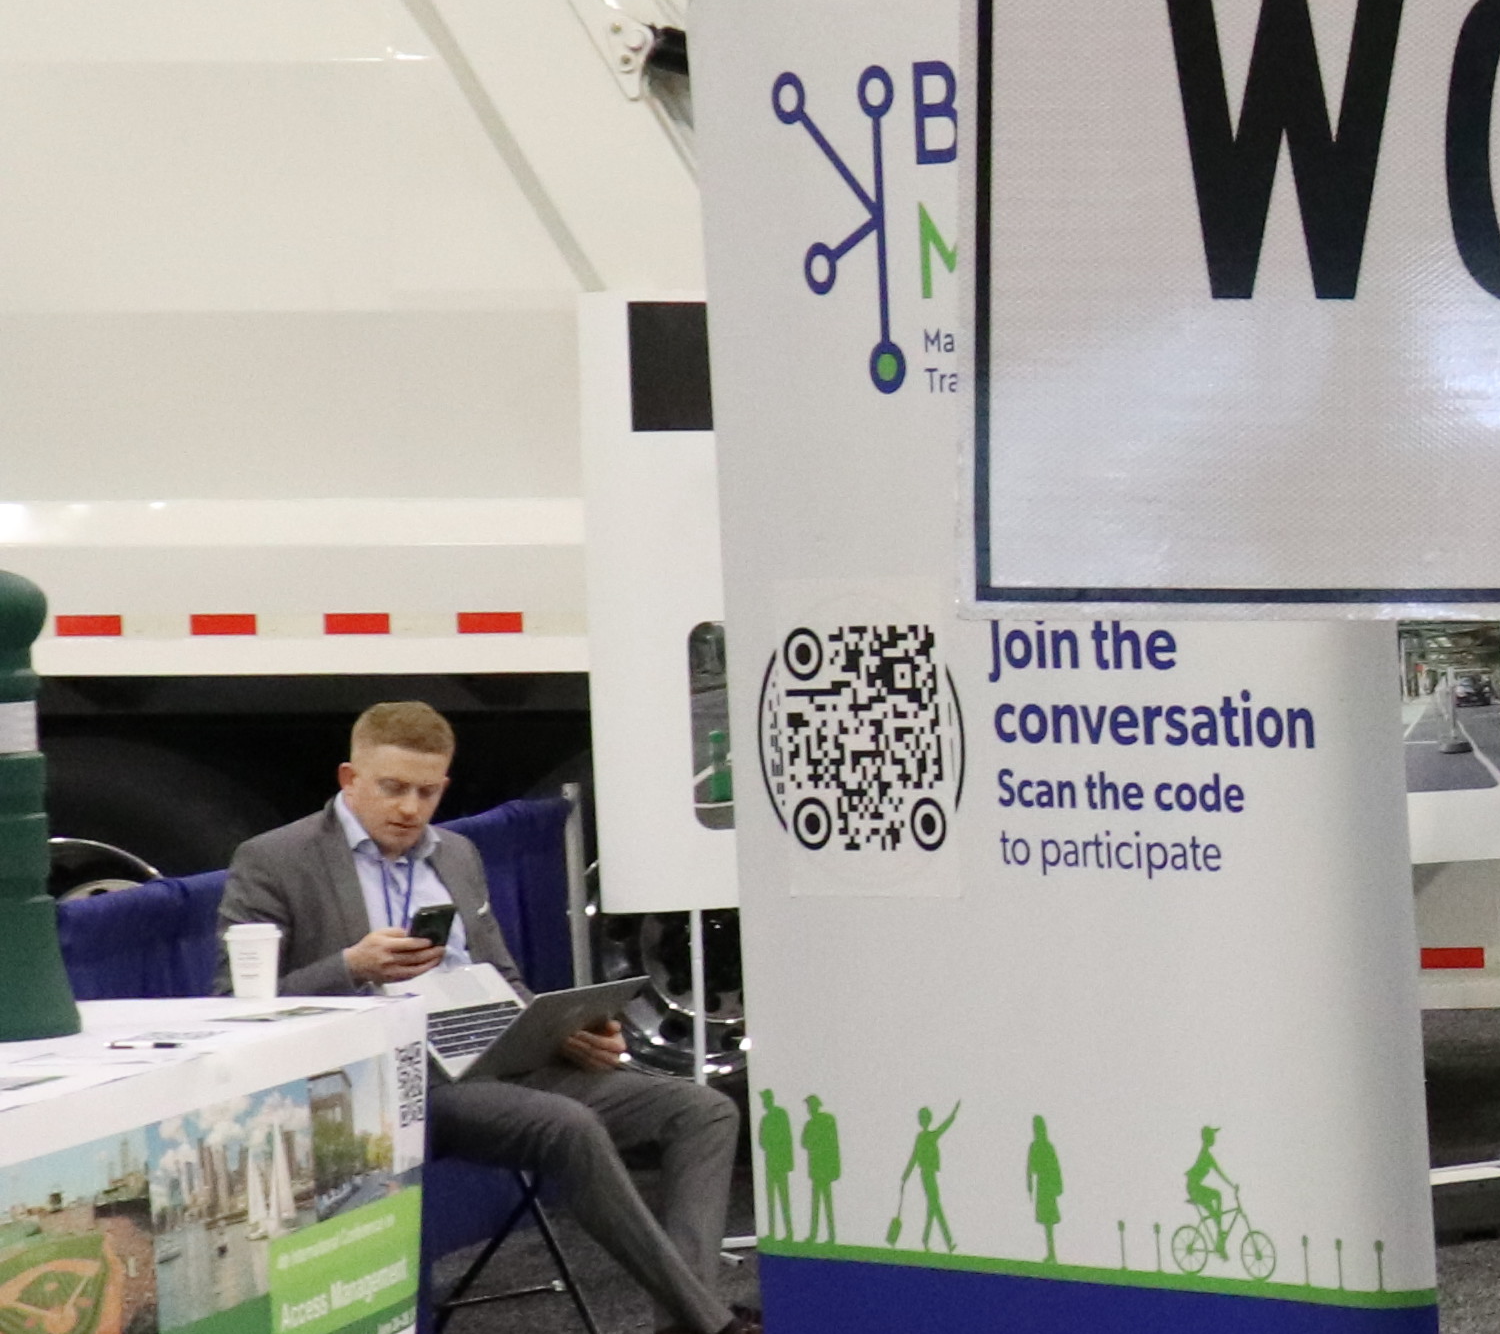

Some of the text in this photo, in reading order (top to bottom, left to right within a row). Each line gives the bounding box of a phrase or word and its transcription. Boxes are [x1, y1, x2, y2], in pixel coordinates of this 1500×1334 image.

[987, 620, 1177, 683] Join the
[993, 691, 1317, 750] conversation
[996, 768, 1246, 814] Scan the code
[1000, 831, 1223, 879] to participate
